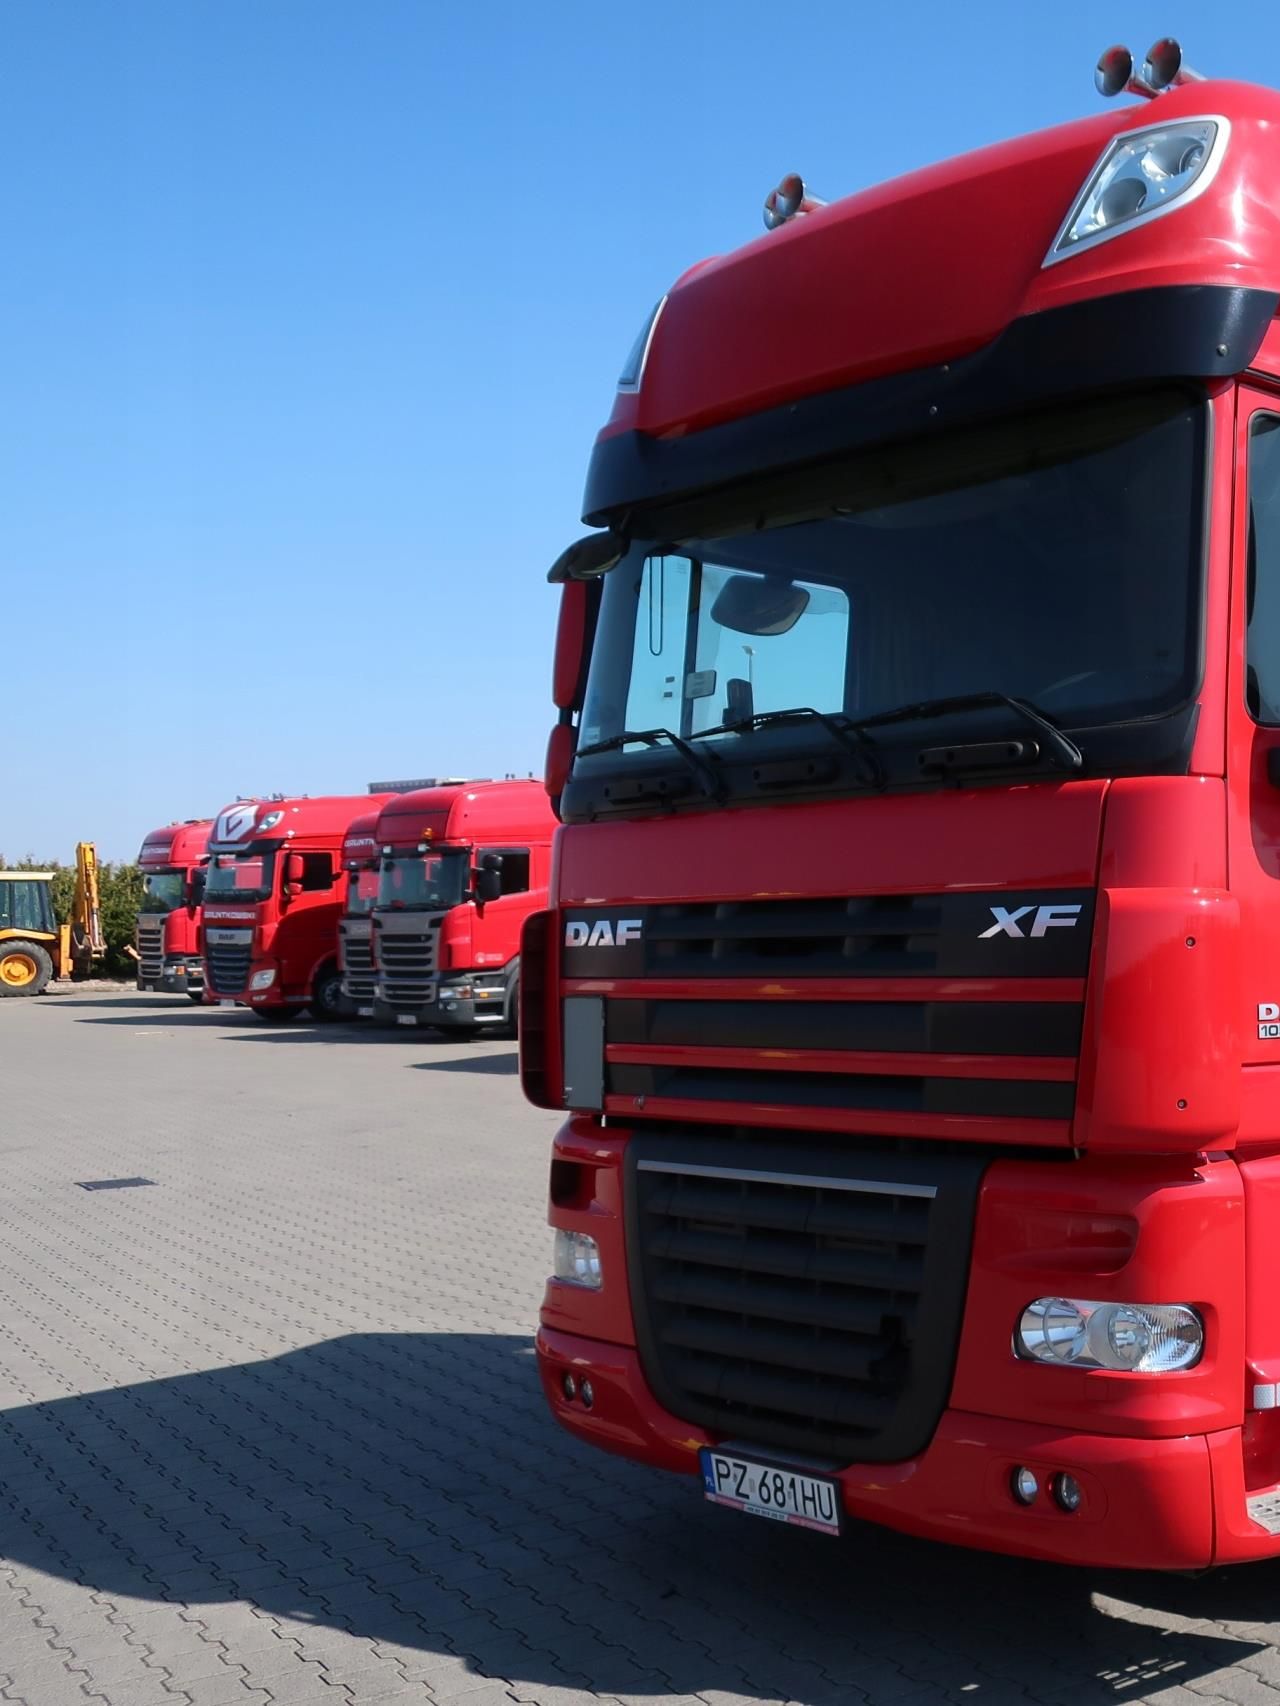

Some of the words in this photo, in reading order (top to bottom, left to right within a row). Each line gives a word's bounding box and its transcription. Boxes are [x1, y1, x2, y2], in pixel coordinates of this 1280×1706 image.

[565, 919, 643, 947] DAF
[977, 904, 1083, 938] XF
[714, 1458, 750, 1500] PZ
[758, 1470, 834, 1521] 681HU
